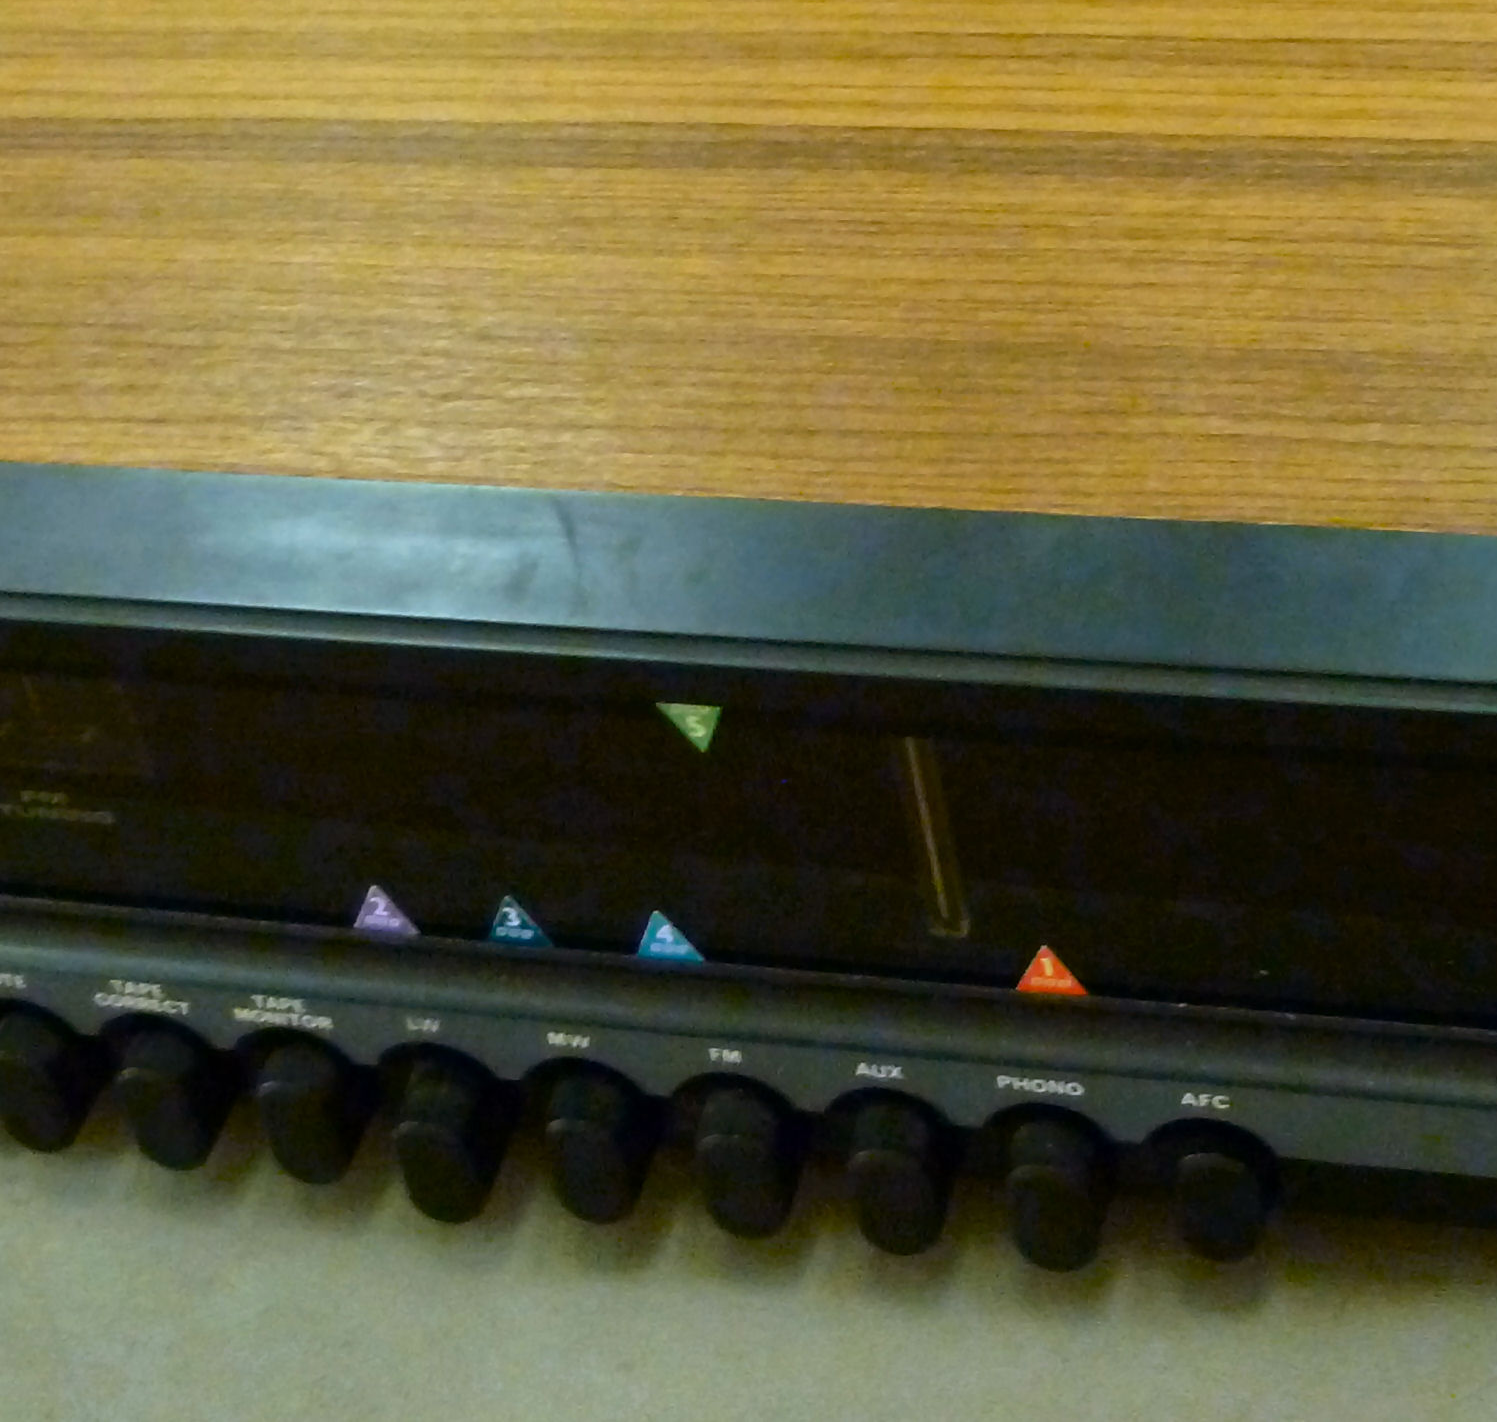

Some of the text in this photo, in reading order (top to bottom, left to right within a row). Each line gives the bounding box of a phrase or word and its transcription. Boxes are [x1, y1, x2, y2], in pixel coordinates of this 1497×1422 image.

[709, 1046, 743, 1065] FM
[854, 1060, 905, 1081] AUX
[996, 1074, 1085, 1097] PHONO
[1181, 1091, 1231, 1111] AFC
